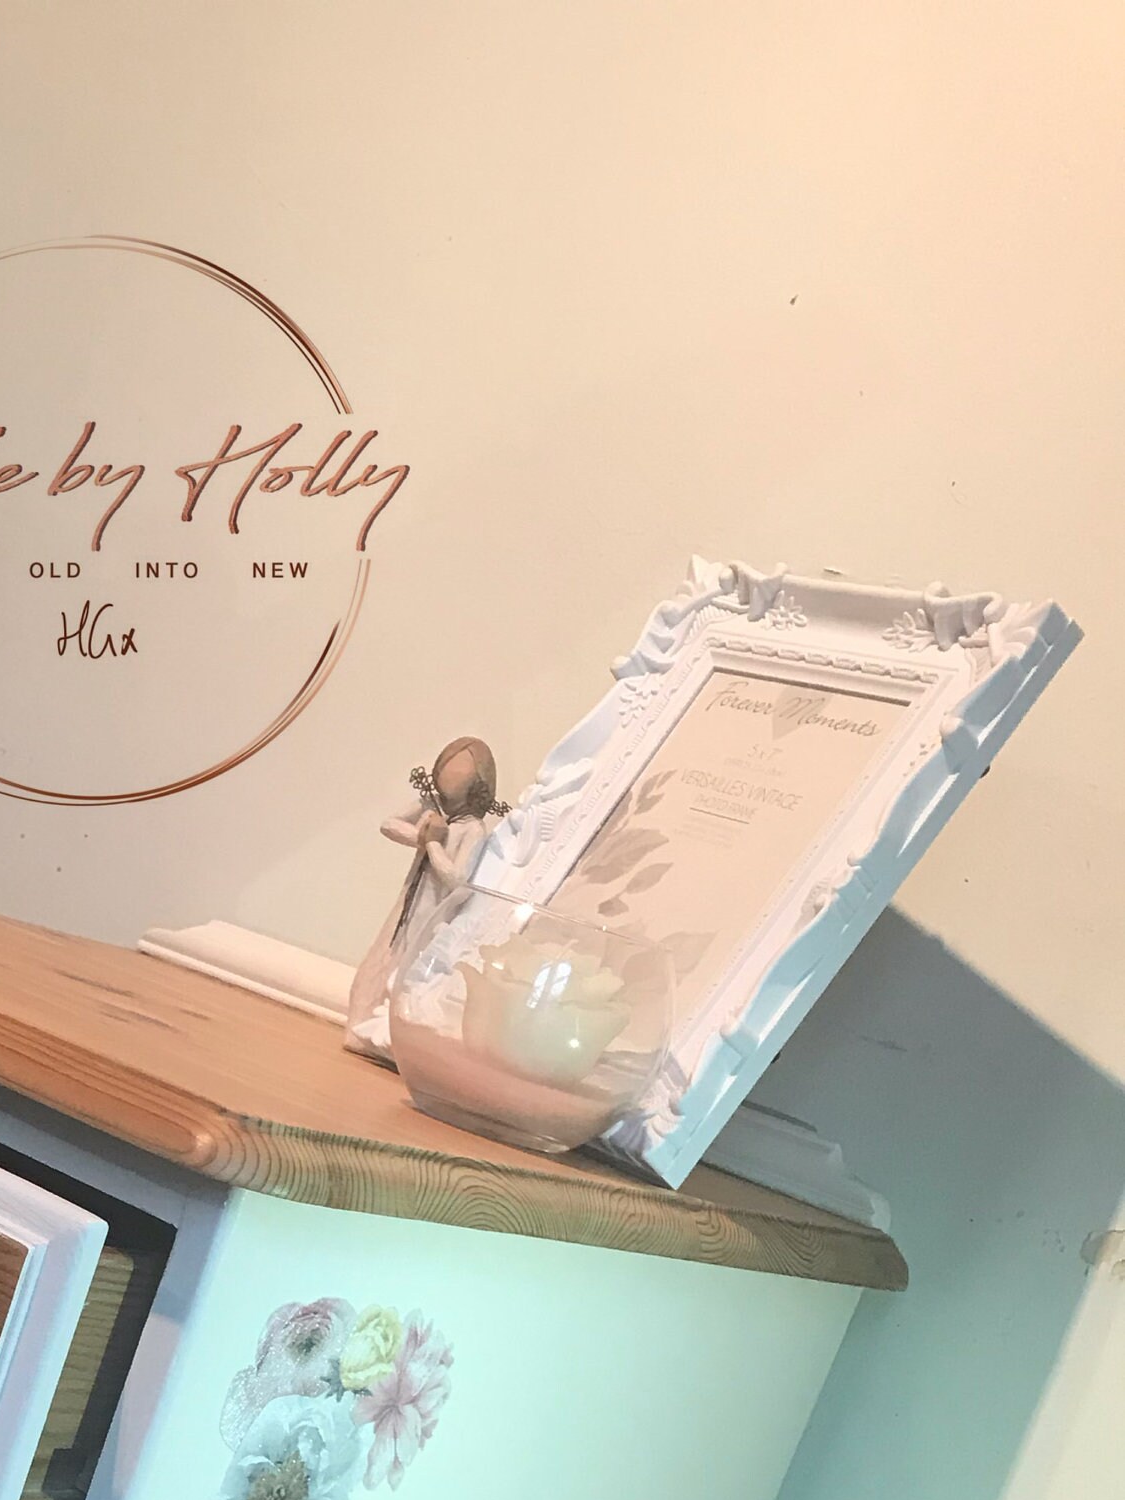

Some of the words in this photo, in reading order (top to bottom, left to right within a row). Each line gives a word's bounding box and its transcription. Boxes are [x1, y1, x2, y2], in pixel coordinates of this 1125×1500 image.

[705, 681, 774, 715] Forever
[779, 696, 883, 737] Moments
[681, 768, 747, 797] VERSAILLES
[748, 783, 803, 811] VINTAGE
